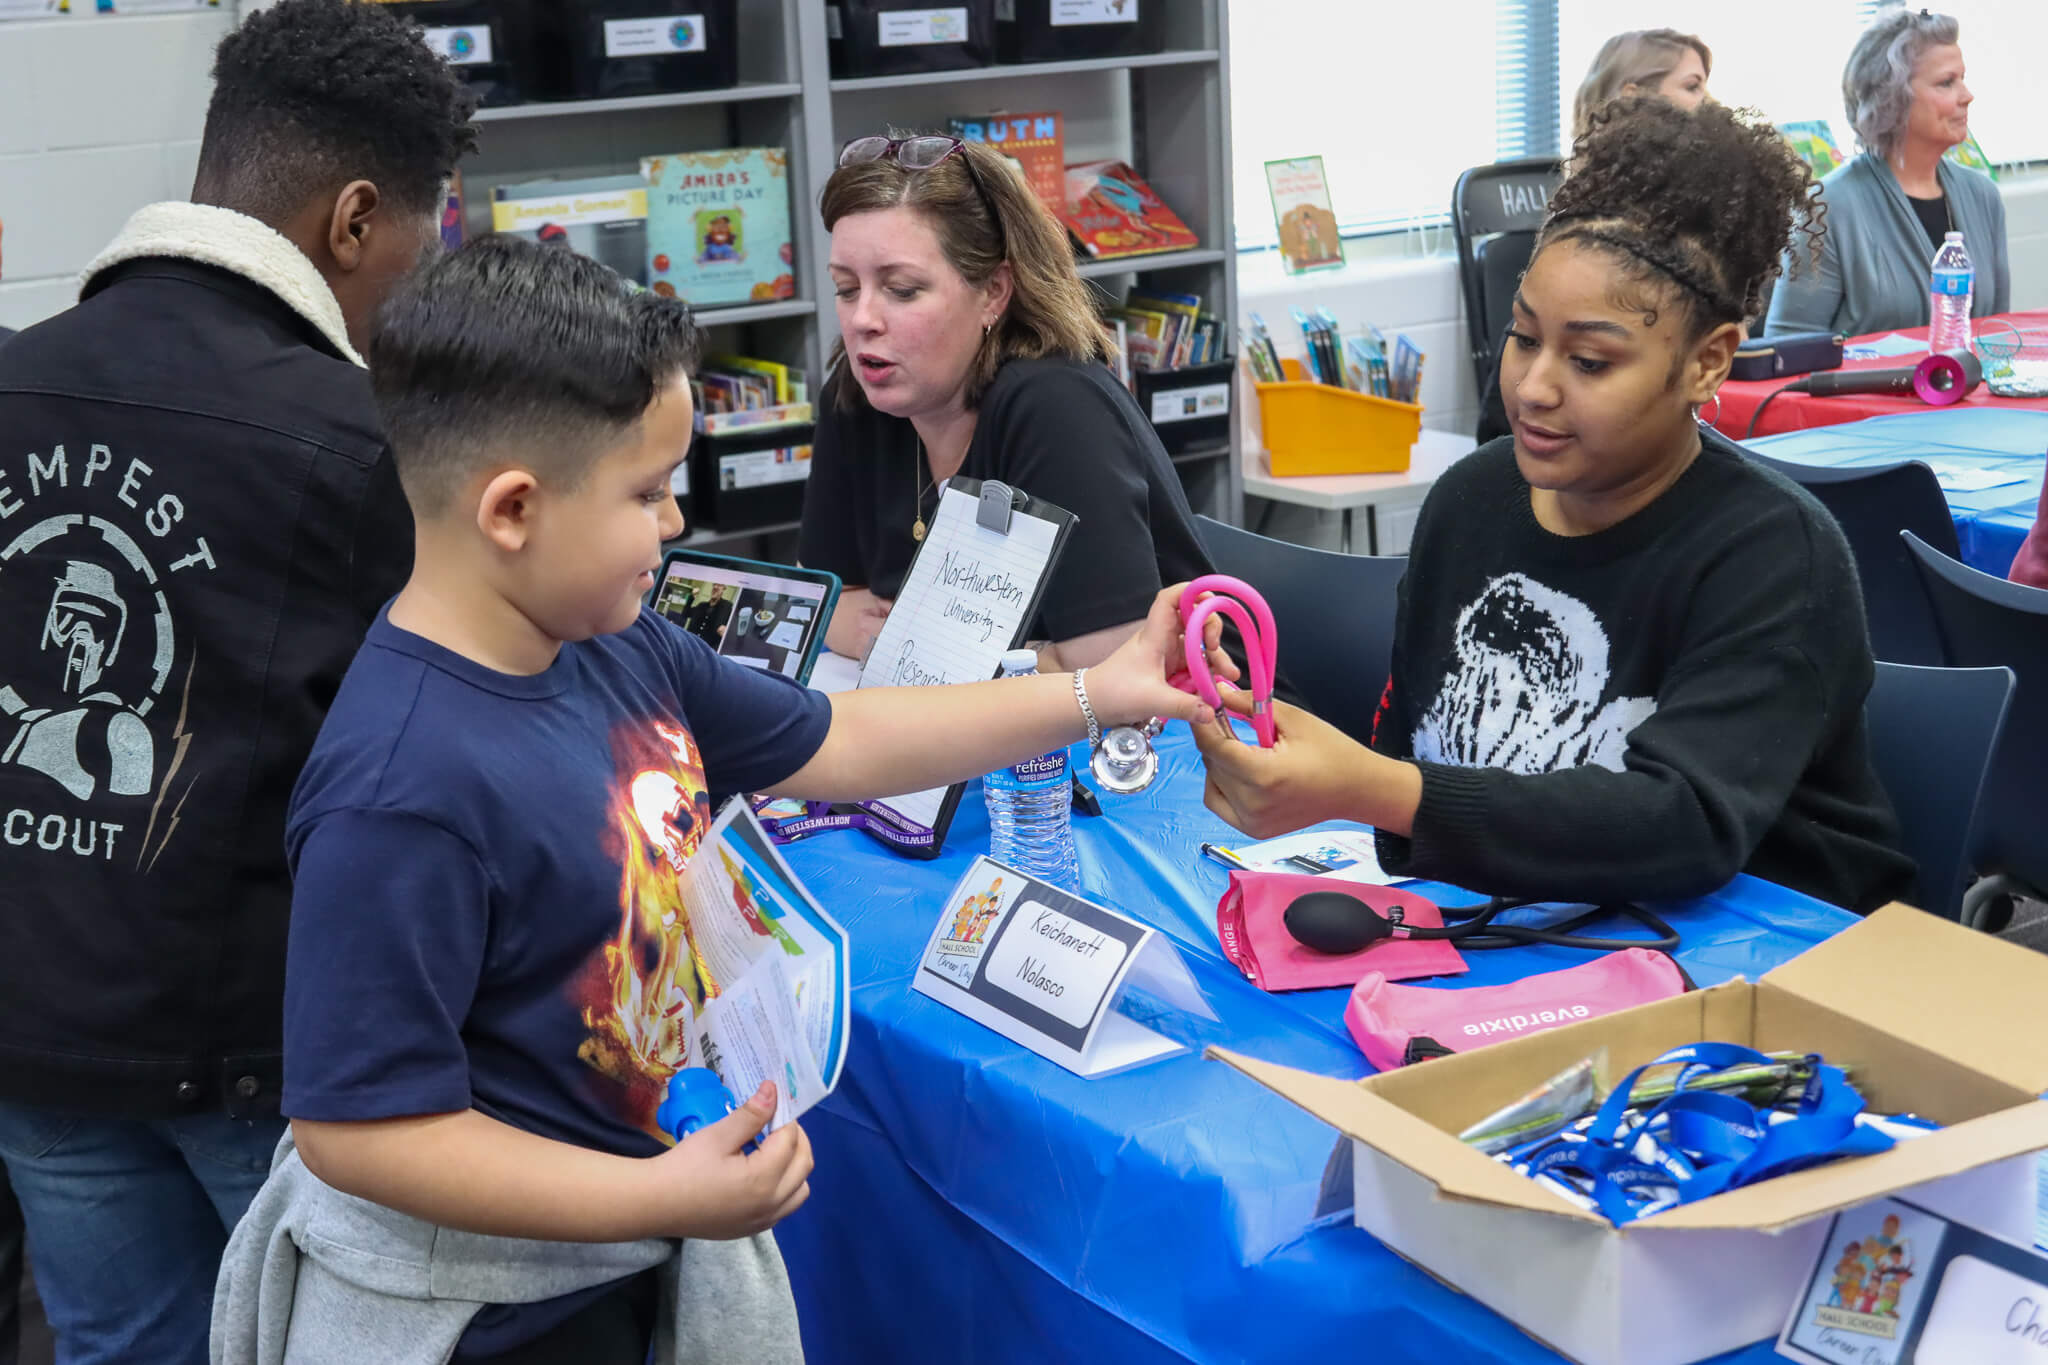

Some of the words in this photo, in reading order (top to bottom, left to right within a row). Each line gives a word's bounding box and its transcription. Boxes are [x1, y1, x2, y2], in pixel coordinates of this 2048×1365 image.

[964, 117, 1055, 143] RUTH
[680, 171, 751, 191] AMIRA'S
[667, 189, 727, 206] PICTURE
[734, 187, 764, 201] DAY
[513, 200, 569, 219] Amanda
[934, 550, 1023, 608] Northwestern
[3, 808, 124, 860] COUT
[785, 815, 850, 837] NORTHWESTERN
[1030, 910, 1106, 958] Keichanett
[955, 944, 977, 954] SCHOOL
[1016, 955, 1065, 998] Nolasco
[1463, 1004, 1590, 1035] everdixie
[1820, 1311, 1840, 1323] HALL
[1847, 1315, 1889, 1333] SCHOOL
